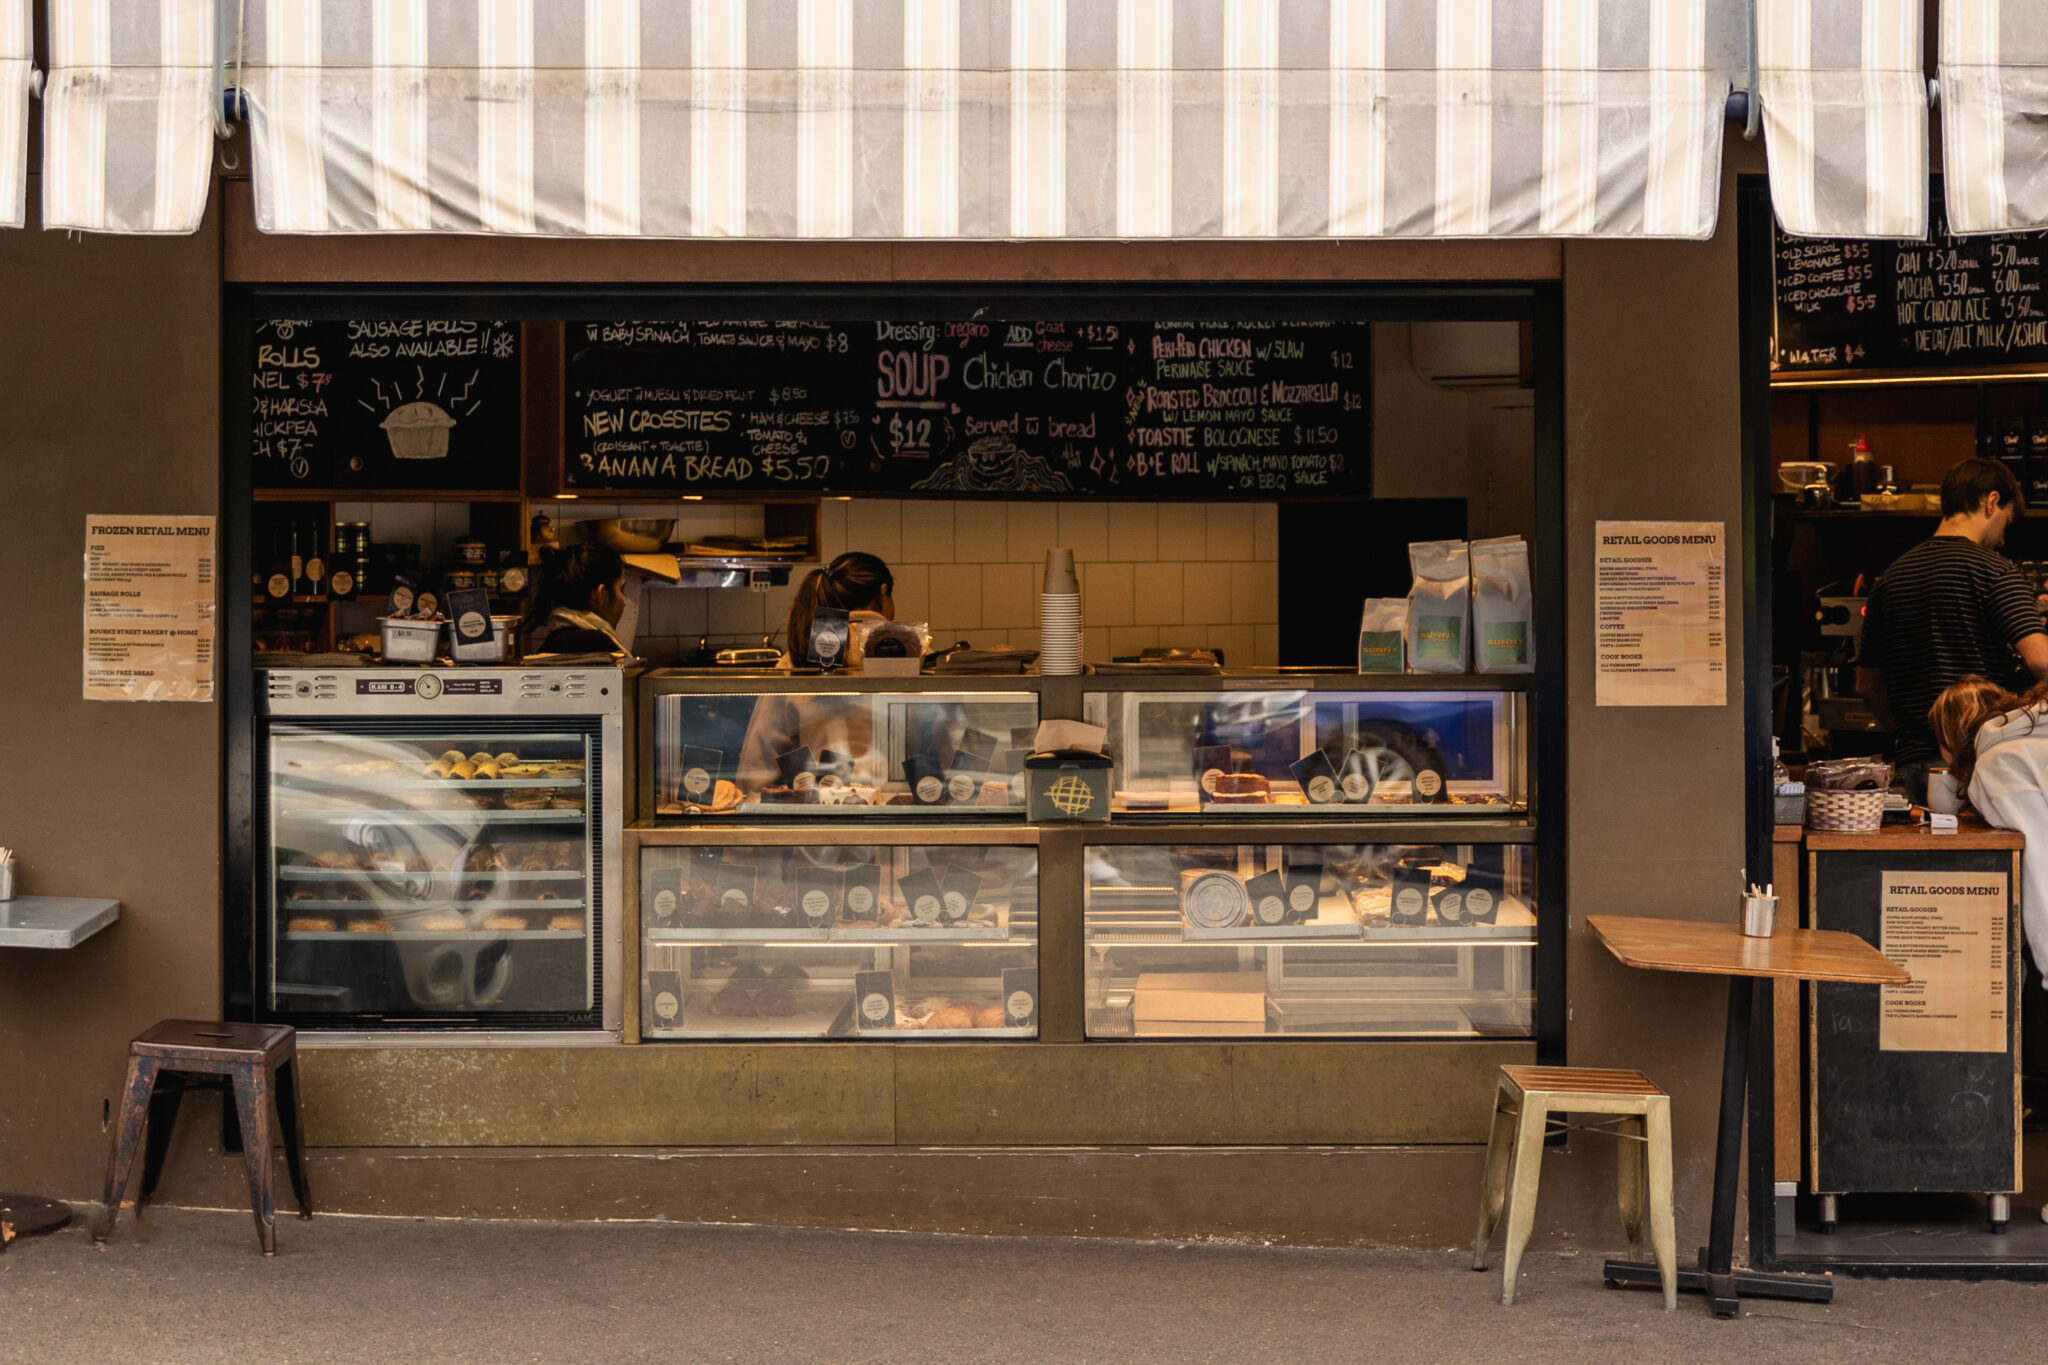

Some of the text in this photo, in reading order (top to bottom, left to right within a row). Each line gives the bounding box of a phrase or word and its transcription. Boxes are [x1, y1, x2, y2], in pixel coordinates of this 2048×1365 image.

[1782, 247, 1802, 259] OLD
[1803, 243, 1841, 256] SCHOOL
[1788, 255, 1843, 271] LEMONADE
[1896, 252, 1921, 275] CHAI
[1807, 269, 1846, 284] COFFEE
[1808, 281, 1861, 300] CHOCOLATE
[1896, 276, 1935, 301] MOCHA
[1795, 301, 1822, 313] MILK
[1896, 301, 1922, 326] HOT
[1923, 297, 1992, 323] CHOCOLATE
[347, 319, 422, 339] SAUSAGE
[1006, 324, 1033, 344] ADD
[1976, 323, 2005, 348] MILK
[348, 342, 390, 358] ALSO
[395, 338, 478, 358] AVAILABLE
[602, 326, 634, 346] BABY
[696, 332, 736, 346] TOMATO
[737, 332, 776, 348] SAUCE
[787, 334, 821, 352] MAYO
[826, 331, 849, 353] $8
[1199, 337, 1252, 359] CHICKEN
[1273, 339, 1305, 360] SLAW
[258, 345, 320, 369] ROLLS
[1217, 359, 1255, 378] SAUCE
[1330, 349, 1354, 369] $12
[1790, 347, 1838, 364] WATER
[877, 350, 1117, 398] SOUP Chicken Chorizo
[586, 388, 633, 407] YOGURT
[1146, 385, 1200, 413] ROASTED
[1202, 382, 1257, 409] BROCCOLI
[1271, 379, 1340, 406] MOZZARELLA
[1342, 389, 1363, 412] $12
[583, 408, 733, 438] NEW CROSSTIES
[750, 410, 775, 425] HAM
[783, 409, 830, 426] CHEESE
[1182, 409, 1222, 424] LEMON
[1224, 408, 1256, 423] MAYO
[1260, 407, 1293, 424] SAUCE
[746, 428, 794, 442] TOMATO
[888, 410, 1097, 456] $12 Served bread
[1136, 426, 1196, 448] TOASTIE
[1203, 426, 1281, 448] BOLOGNESE
[751, 441, 800, 457] CHEESE
[683, 456, 753, 481] BREAD
[760, 453, 830, 482] $5.50
[1171, 450, 1201, 476] ROLL
[1291, 453, 1327, 470] TOMATO
[1258, 472, 1288, 492] BBQ
[1293, 469, 1329, 486] SAUCE
[91, 526, 211, 537] FROZEN RETAIL MENU
[1603, 536, 1716, 545] RETAIL GOODS MENU
[89, 628, 116, 636] BOURKE
[1417, 632, 1458, 641] SUNNY
[1486, 638, 1525, 646] SUNNY
[1889, 886, 2000, 896] RETAIL GOODS MENU
